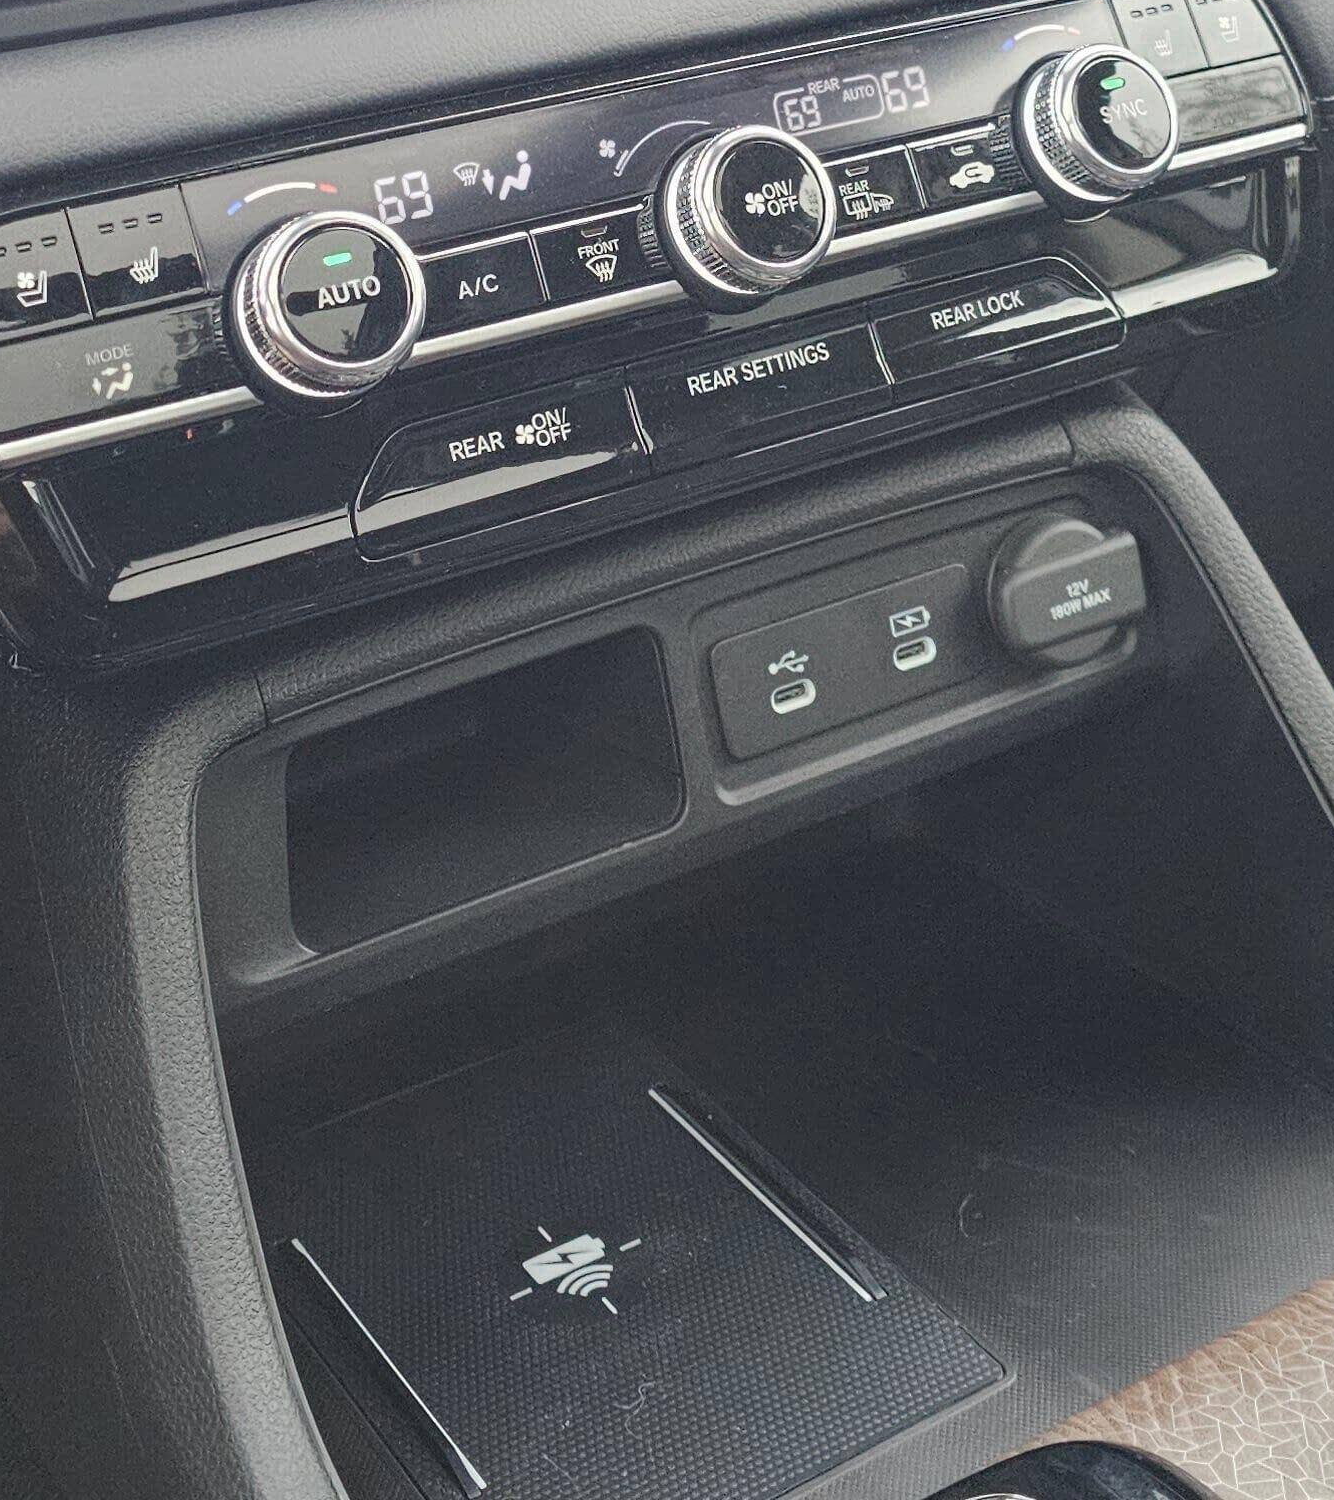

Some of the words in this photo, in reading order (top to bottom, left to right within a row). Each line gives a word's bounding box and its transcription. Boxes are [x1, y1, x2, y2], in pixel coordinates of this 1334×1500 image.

[806, 77, 841, 95] REAR
[842, 84, 876, 103] AUTO
[880, 64, 931, 114] 69
[782, 94, 823, 132] 69
[1099, 98, 1149, 125] SYNC
[372, 170, 435, 227] 69
[761, 178, 793, 201] ON/
[838, 178, 870, 198] REAR
[766, 194, 799, 217] OFF
[577, 236, 620, 260] FRONT
[316, 275, 382, 310] AUTO
[457, 274, 500, 300] A/C
[929, 301, 978, 331] REAR
[978, 289, 1025, 319] LOCK
[84, 342, 135, 367] MODE
[686, 364, 739, 397] REAR
[739, 341, 831, 384] SETTINGS
[531, 406, 568, 431] ON/
[448, 431, 506, 463] REAR
[535, 424, 572, 448] OFF
[1065, 577, 1089, 599] 12V
[1081, 586, 1113, 610] MAX
